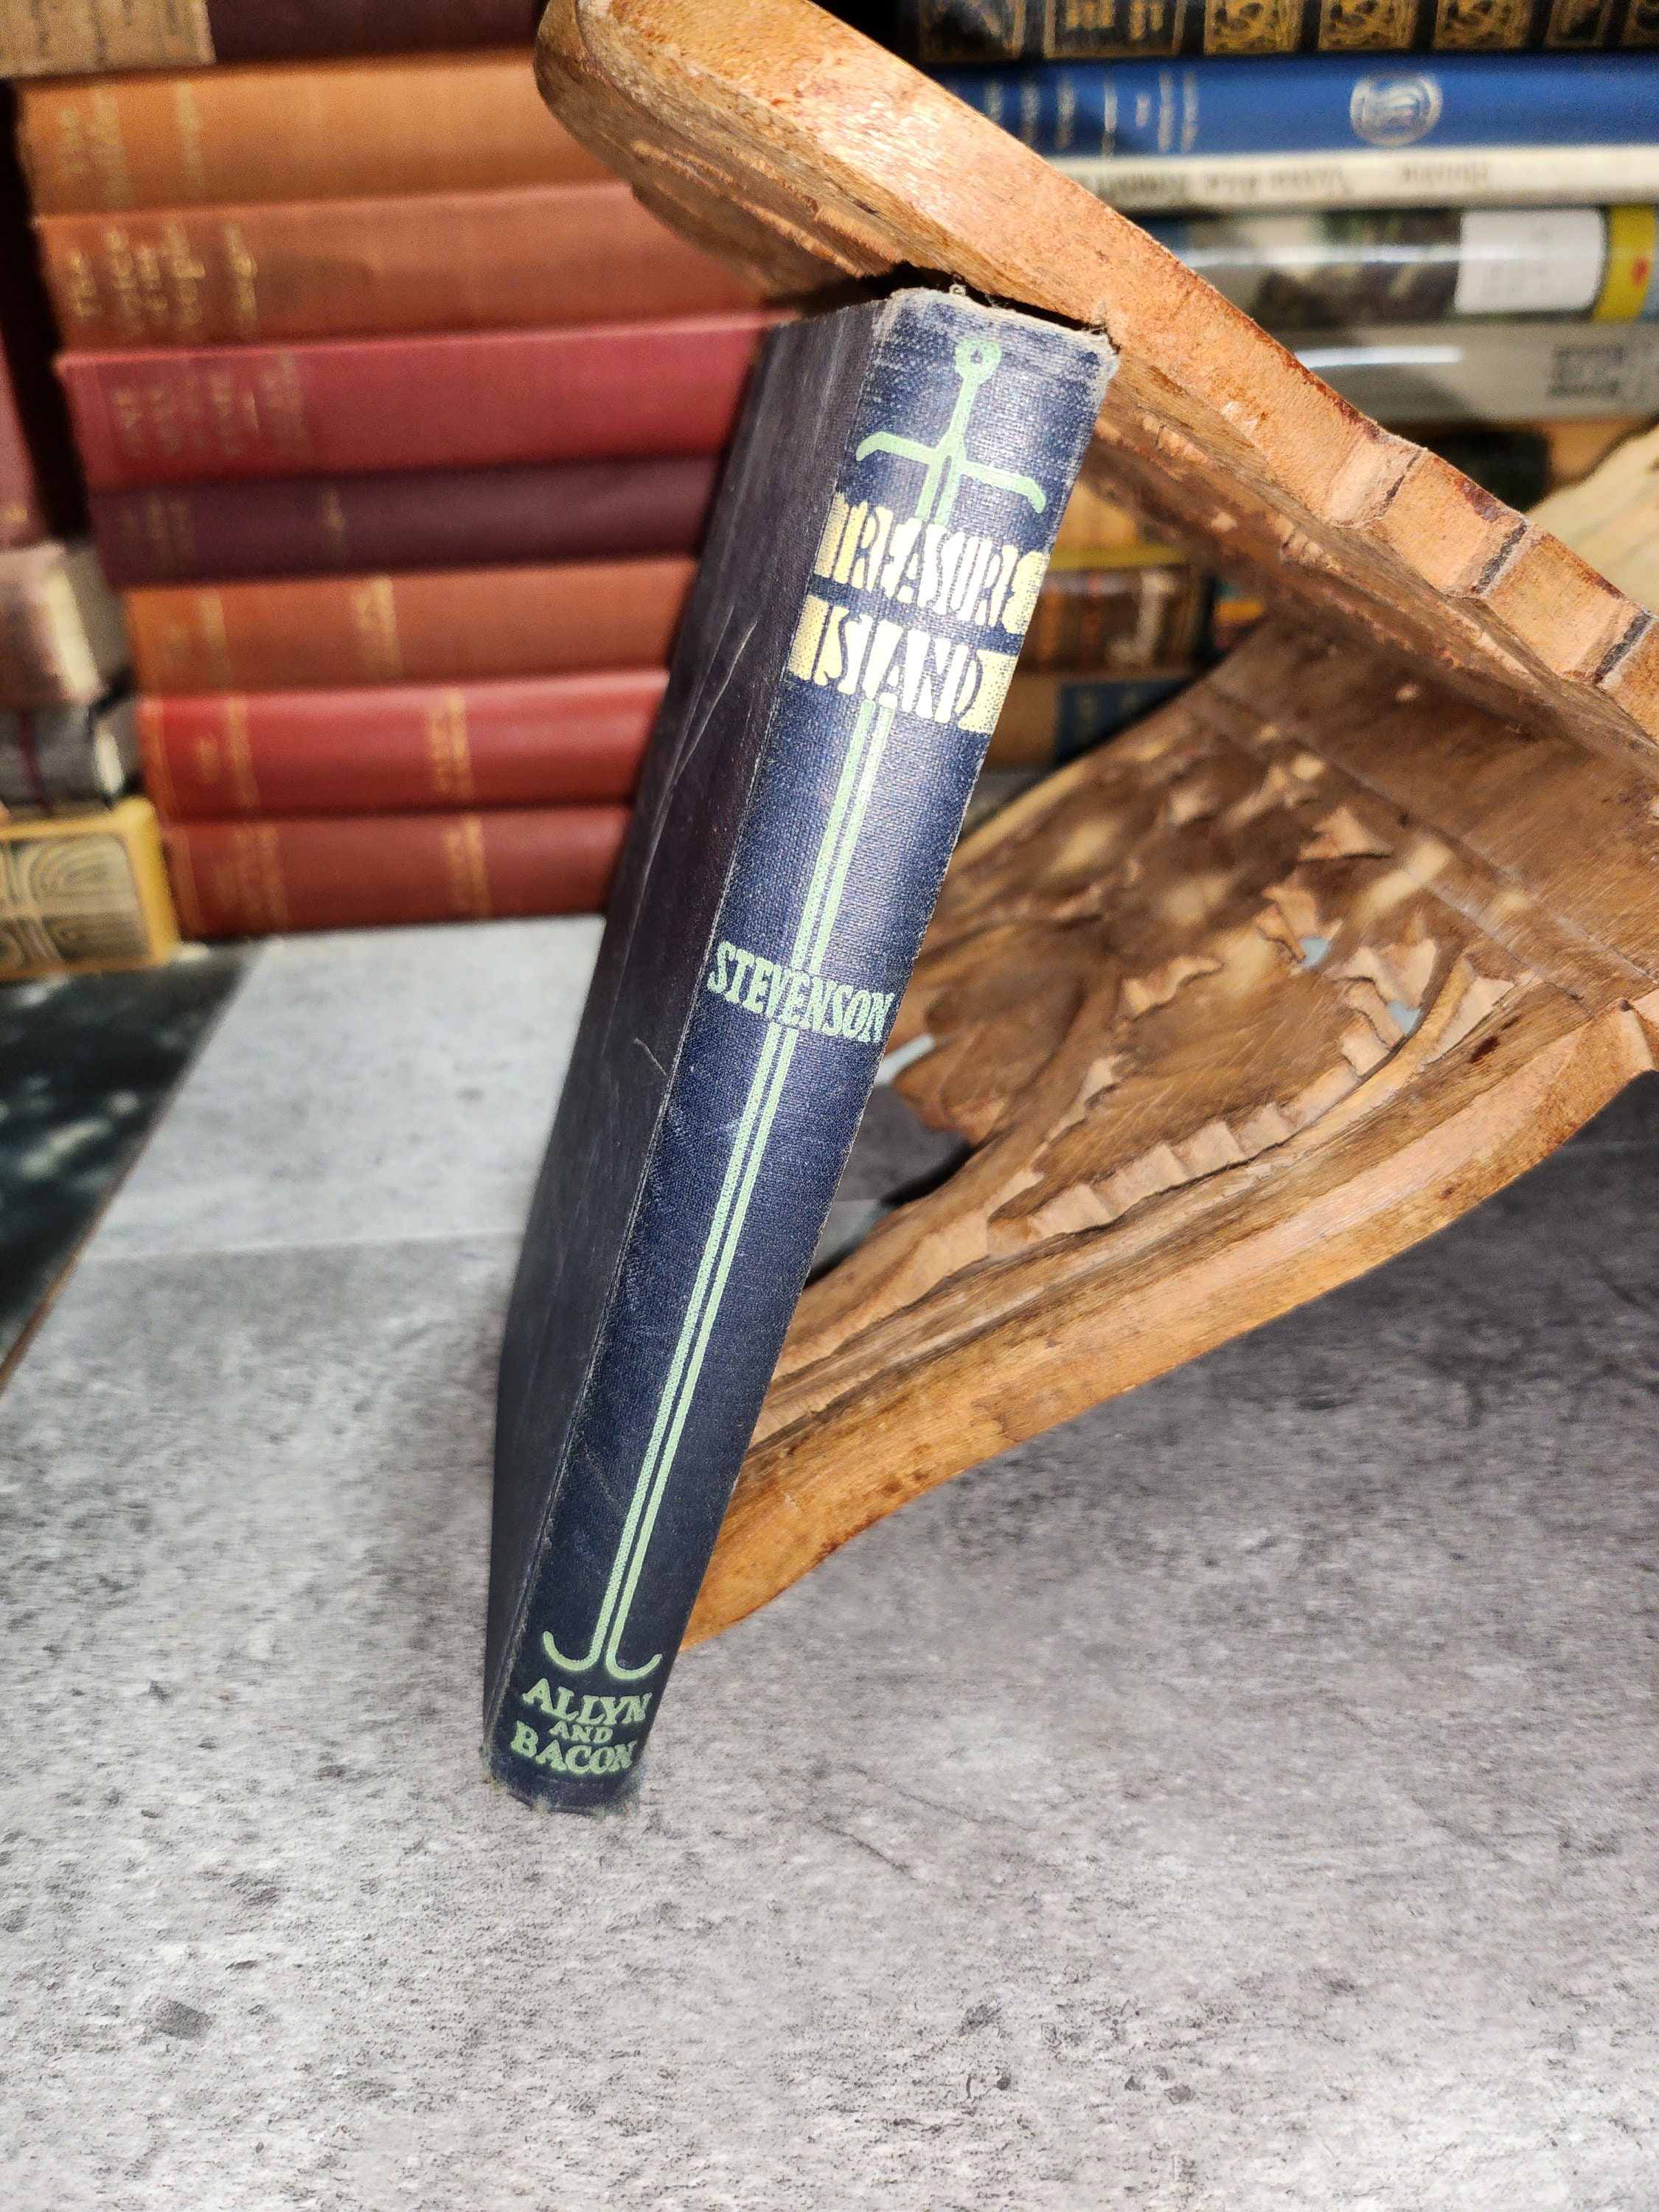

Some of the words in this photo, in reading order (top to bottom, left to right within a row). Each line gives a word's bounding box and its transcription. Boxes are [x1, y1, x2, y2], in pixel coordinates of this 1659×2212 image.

[817, 493, 1048, 634] TREASURE
[793, 598, 1009, 731] ISLAND
[707, 940, 894, 1043] STEVENSON
[522, 1677, 653, 1725] ALLYN
[549, 1720, 613, 1744] AND
[510, 1720, 638, 1775] BACON
